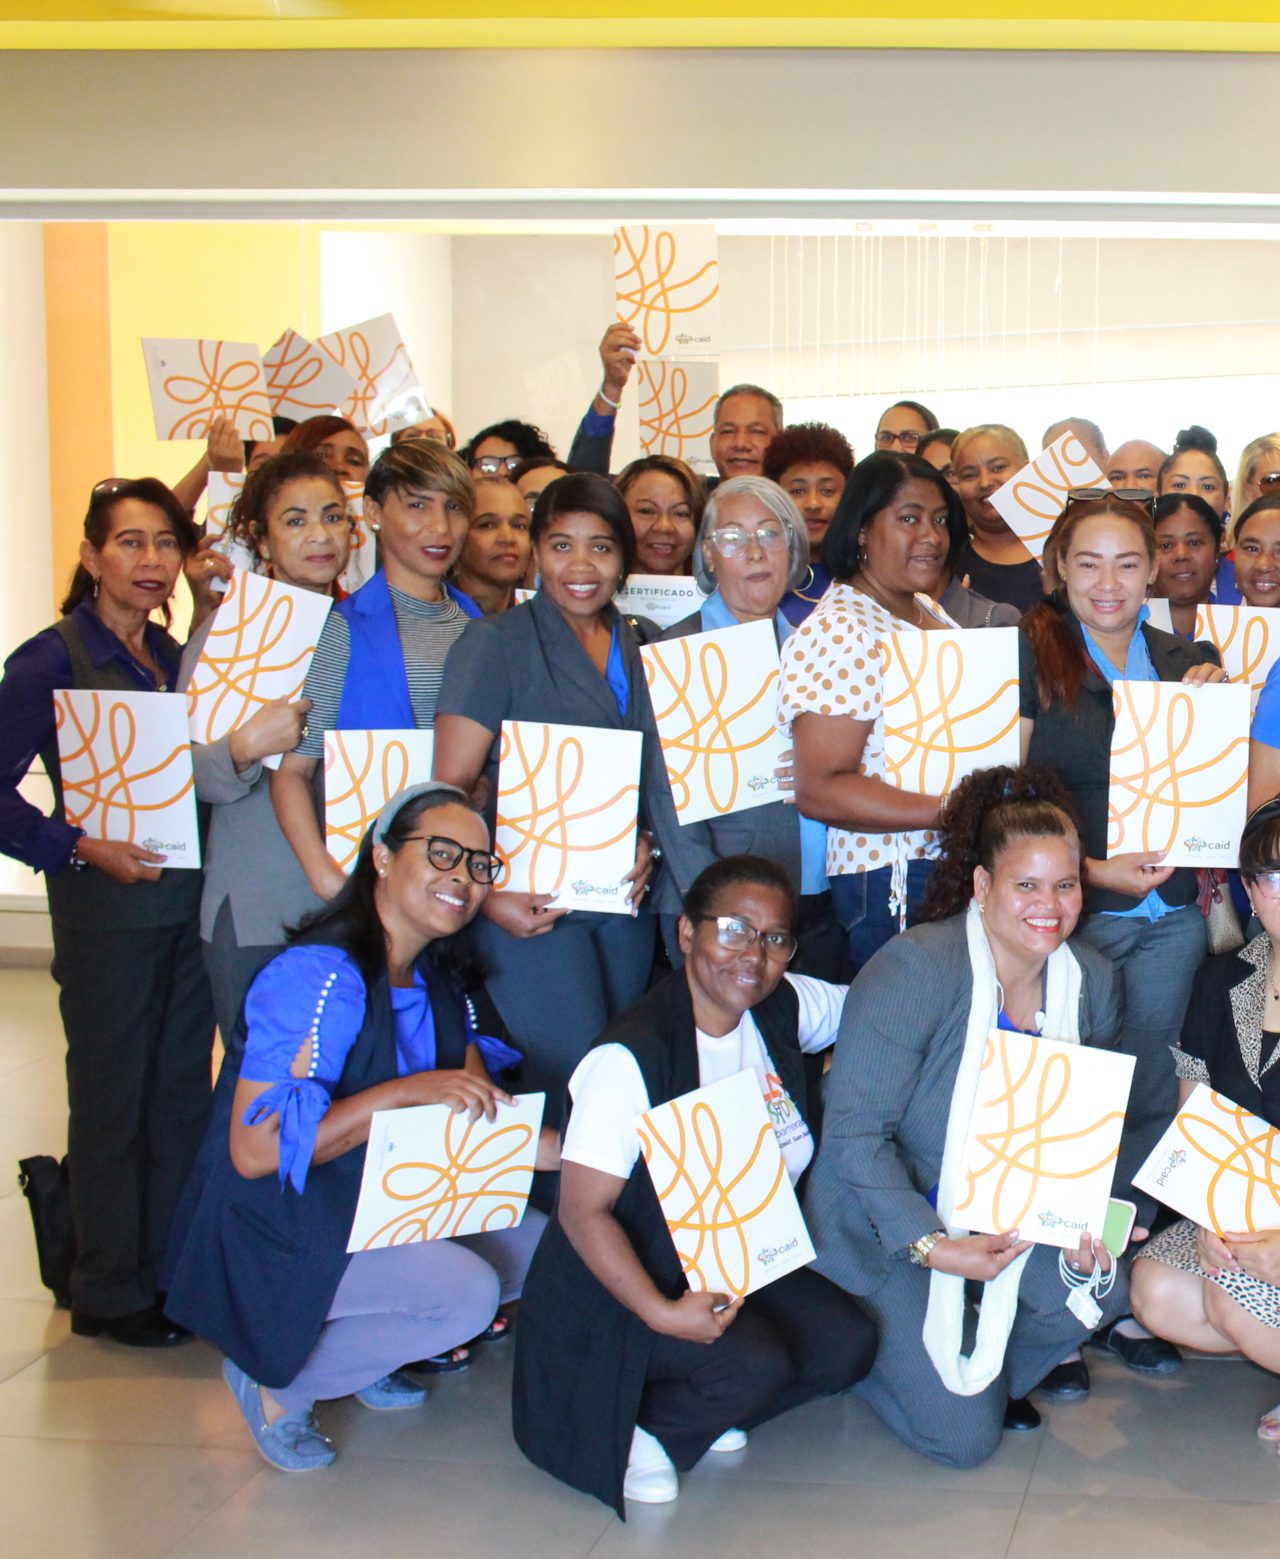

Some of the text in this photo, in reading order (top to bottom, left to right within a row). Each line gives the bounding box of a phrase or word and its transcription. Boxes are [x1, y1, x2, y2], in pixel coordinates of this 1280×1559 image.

[624, 587, 694, 597] CERTIFICADO
[165, 841, 186, 851] caid
[1208, 840, 1231, 850] caid
[595, 884, 618, 895] caid
[1156, 1166, 1172, 1187] caid
[1063, 1219, 1089, 1231] caid
[779, 1236, 798, 1254] caid
